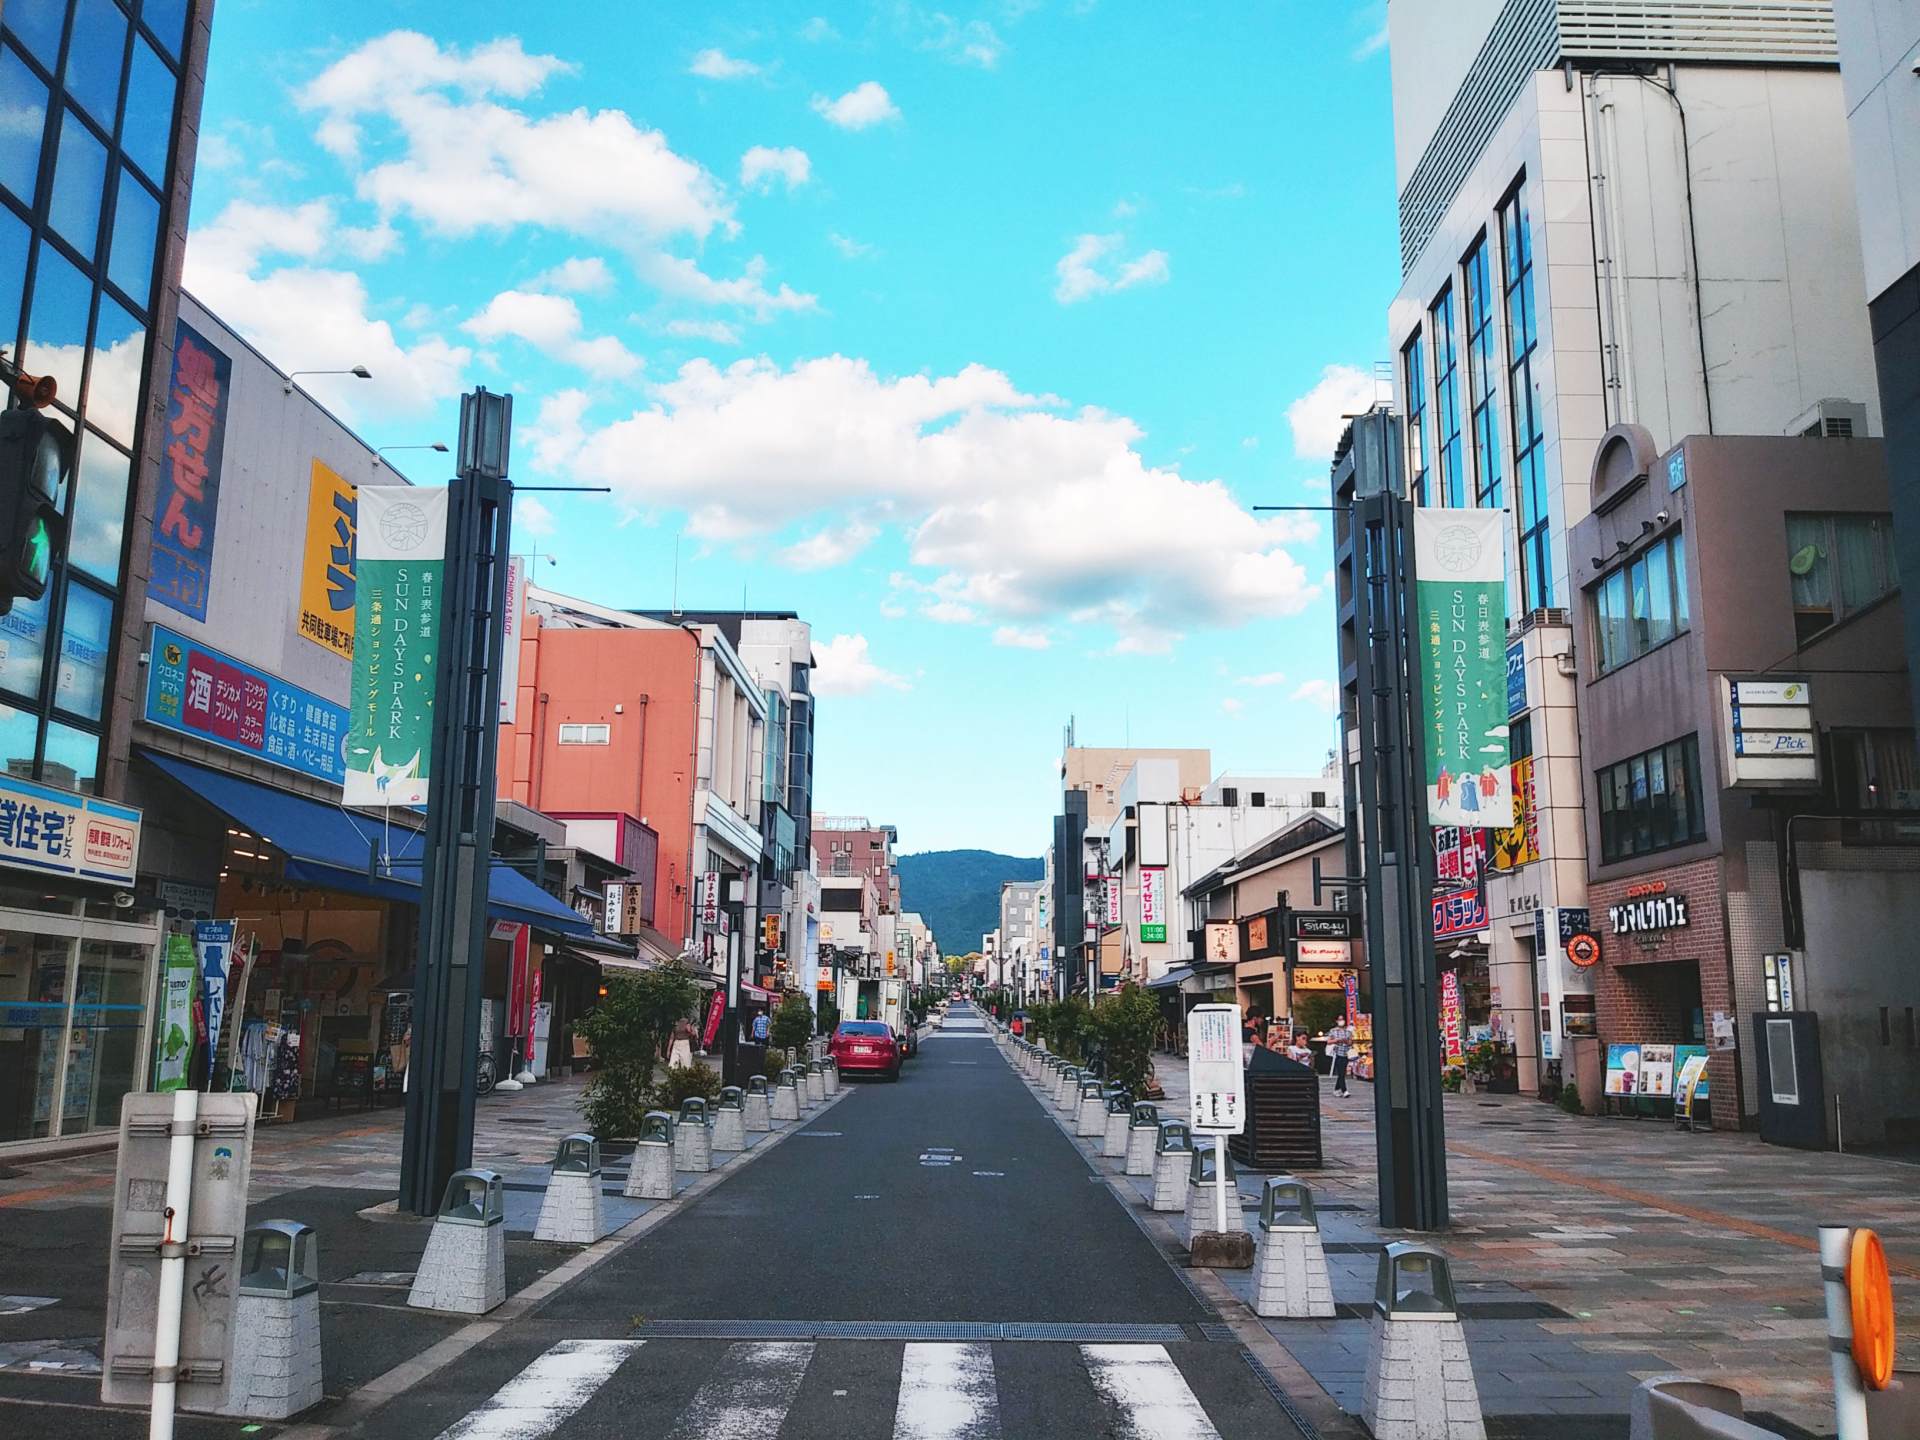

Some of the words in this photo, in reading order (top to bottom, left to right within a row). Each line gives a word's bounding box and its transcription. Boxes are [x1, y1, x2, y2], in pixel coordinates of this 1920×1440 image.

[395, 568, 409, 611] SUN
[418, 571, 433, 638] 春日表参道
[1451, 590, 1465, 632] SUN
[392, 618, 408, 676] DAYS
[1477, 593, 1491, 660] 春日表参道
[157, 663, 185, 682] クロネコ
[365, 589, 383, 737] 三条通ショッピングモール
[1429, 609, 1446, 757] 三条通ショッピングモール
[1453, 640, 1466, 697] DAYS
[161, 680, 179, 695] ヤマト
[188, 667, 213, 714] 酒
[215, 679, 242, 702] デジカメ
[244, 679, 268, 698] コンタクト
[246, 697, 264, 713] レンズ
[215, 701, 239, 724] プリント
[244, 715, 262, 729] カラー
[389, 682, 404, 739] PARK
[1456, 702, 1471, 760] PARK
[240, 727, 264, 746] コンタクト
[62, 814, 76, 859] サービス
[607, 891, 616, 931] おみやげ処
[703, 873, 716, 923] 餃子の王将
[1110, 887, 1118, 922] サイゼリヤ
[1142, 872, 1153, 923] サイゼリヤ
[1608, 896, 1687, 934] サンマルクカフェ
